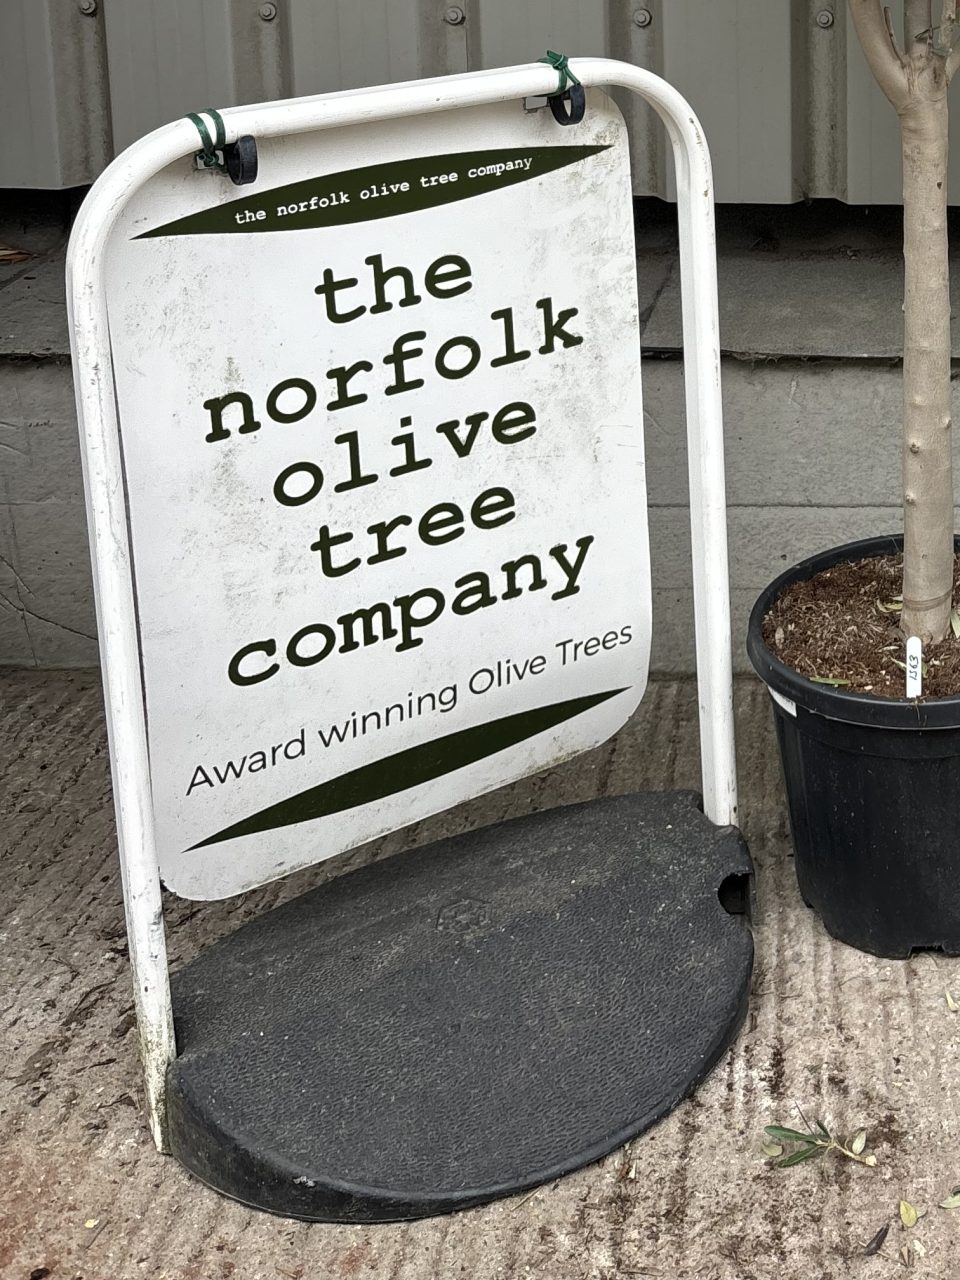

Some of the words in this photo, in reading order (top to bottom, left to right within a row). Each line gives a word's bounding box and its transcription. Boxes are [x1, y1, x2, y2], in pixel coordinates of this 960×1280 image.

[235, 205, 267, 224] the
[276, 185, 350, 217] norfolk
[359, 177, 410, 201] olive
[420, 169, 459, 190] tree
[467, 155, 534, 183] company
[314, 253, 473, 324] the
[203, 297, 584, 443] norfolk
[273, 401, 537, 507] olive
[310, 486, 516, 578] tree
[227, 535, 595, 687] company
[185, 729, 306, 796] Award
[318, 682, 459, 748] winning
[468, 653, 547, 696] Olive
[555, 624, 633, 668] Trees
